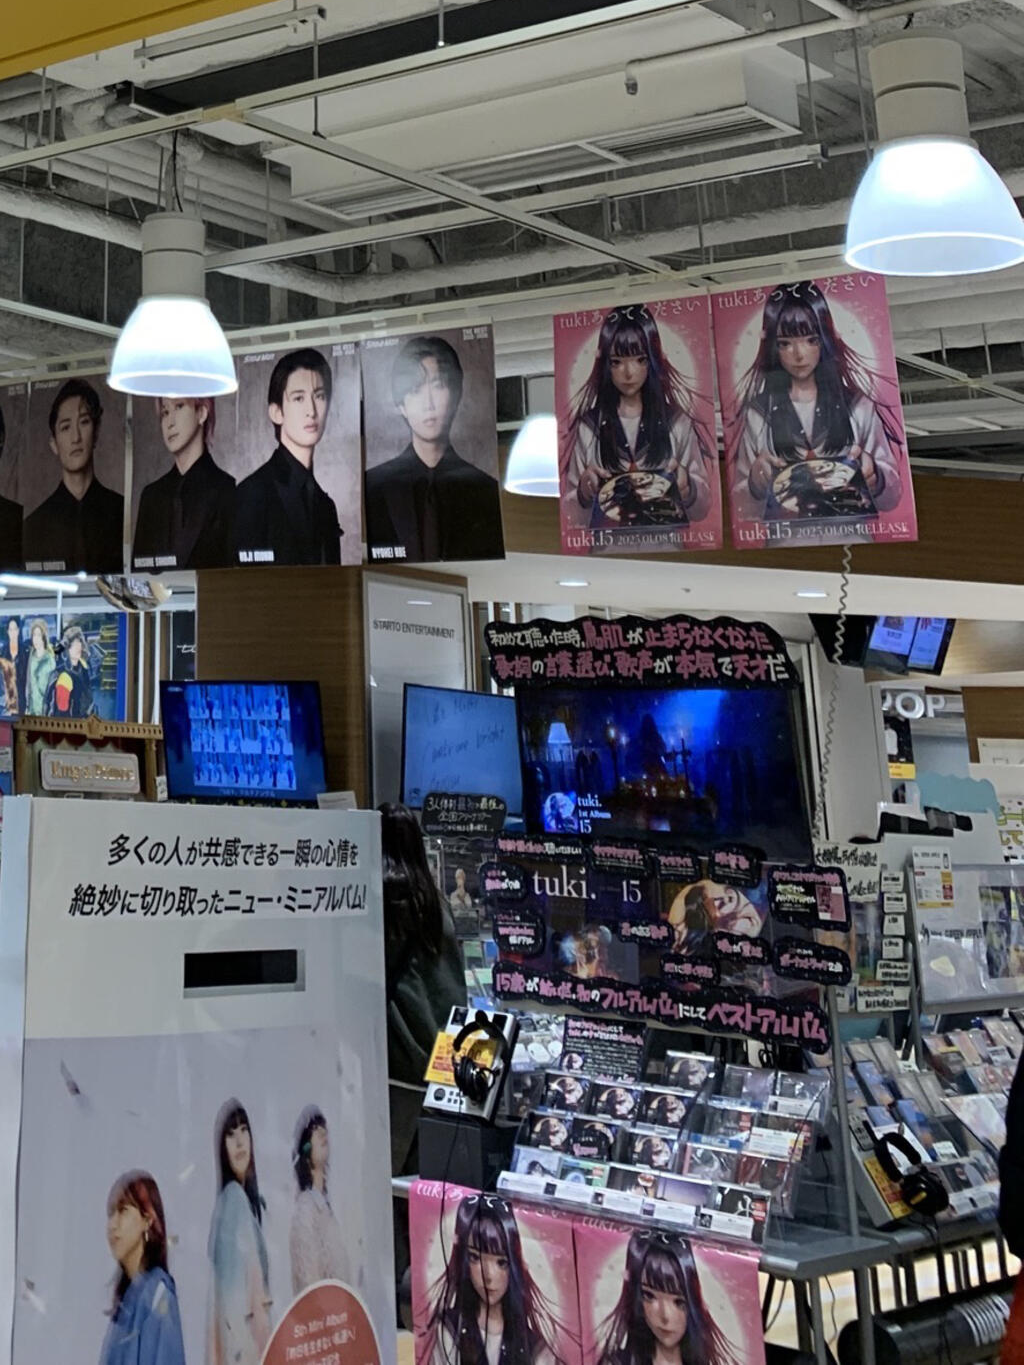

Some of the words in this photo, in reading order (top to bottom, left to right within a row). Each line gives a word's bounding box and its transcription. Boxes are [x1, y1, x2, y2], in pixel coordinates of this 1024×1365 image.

[373, 620, 401, 632] STARTO
[402, 622, 455, 640] ENTERTAINMENT
[578, 793, 602, 807] tuki.
[579, 820, 592, 833] 15
[108, 834, 359, 868] 多くの人が共感できる一瞬の心情を
[532, 864, 596, 900] tuki.
[622, 880, 642, 903] 15
[69, 883, 367, 918] 絶妙に切り取ったニュー・ミニアルバム!
